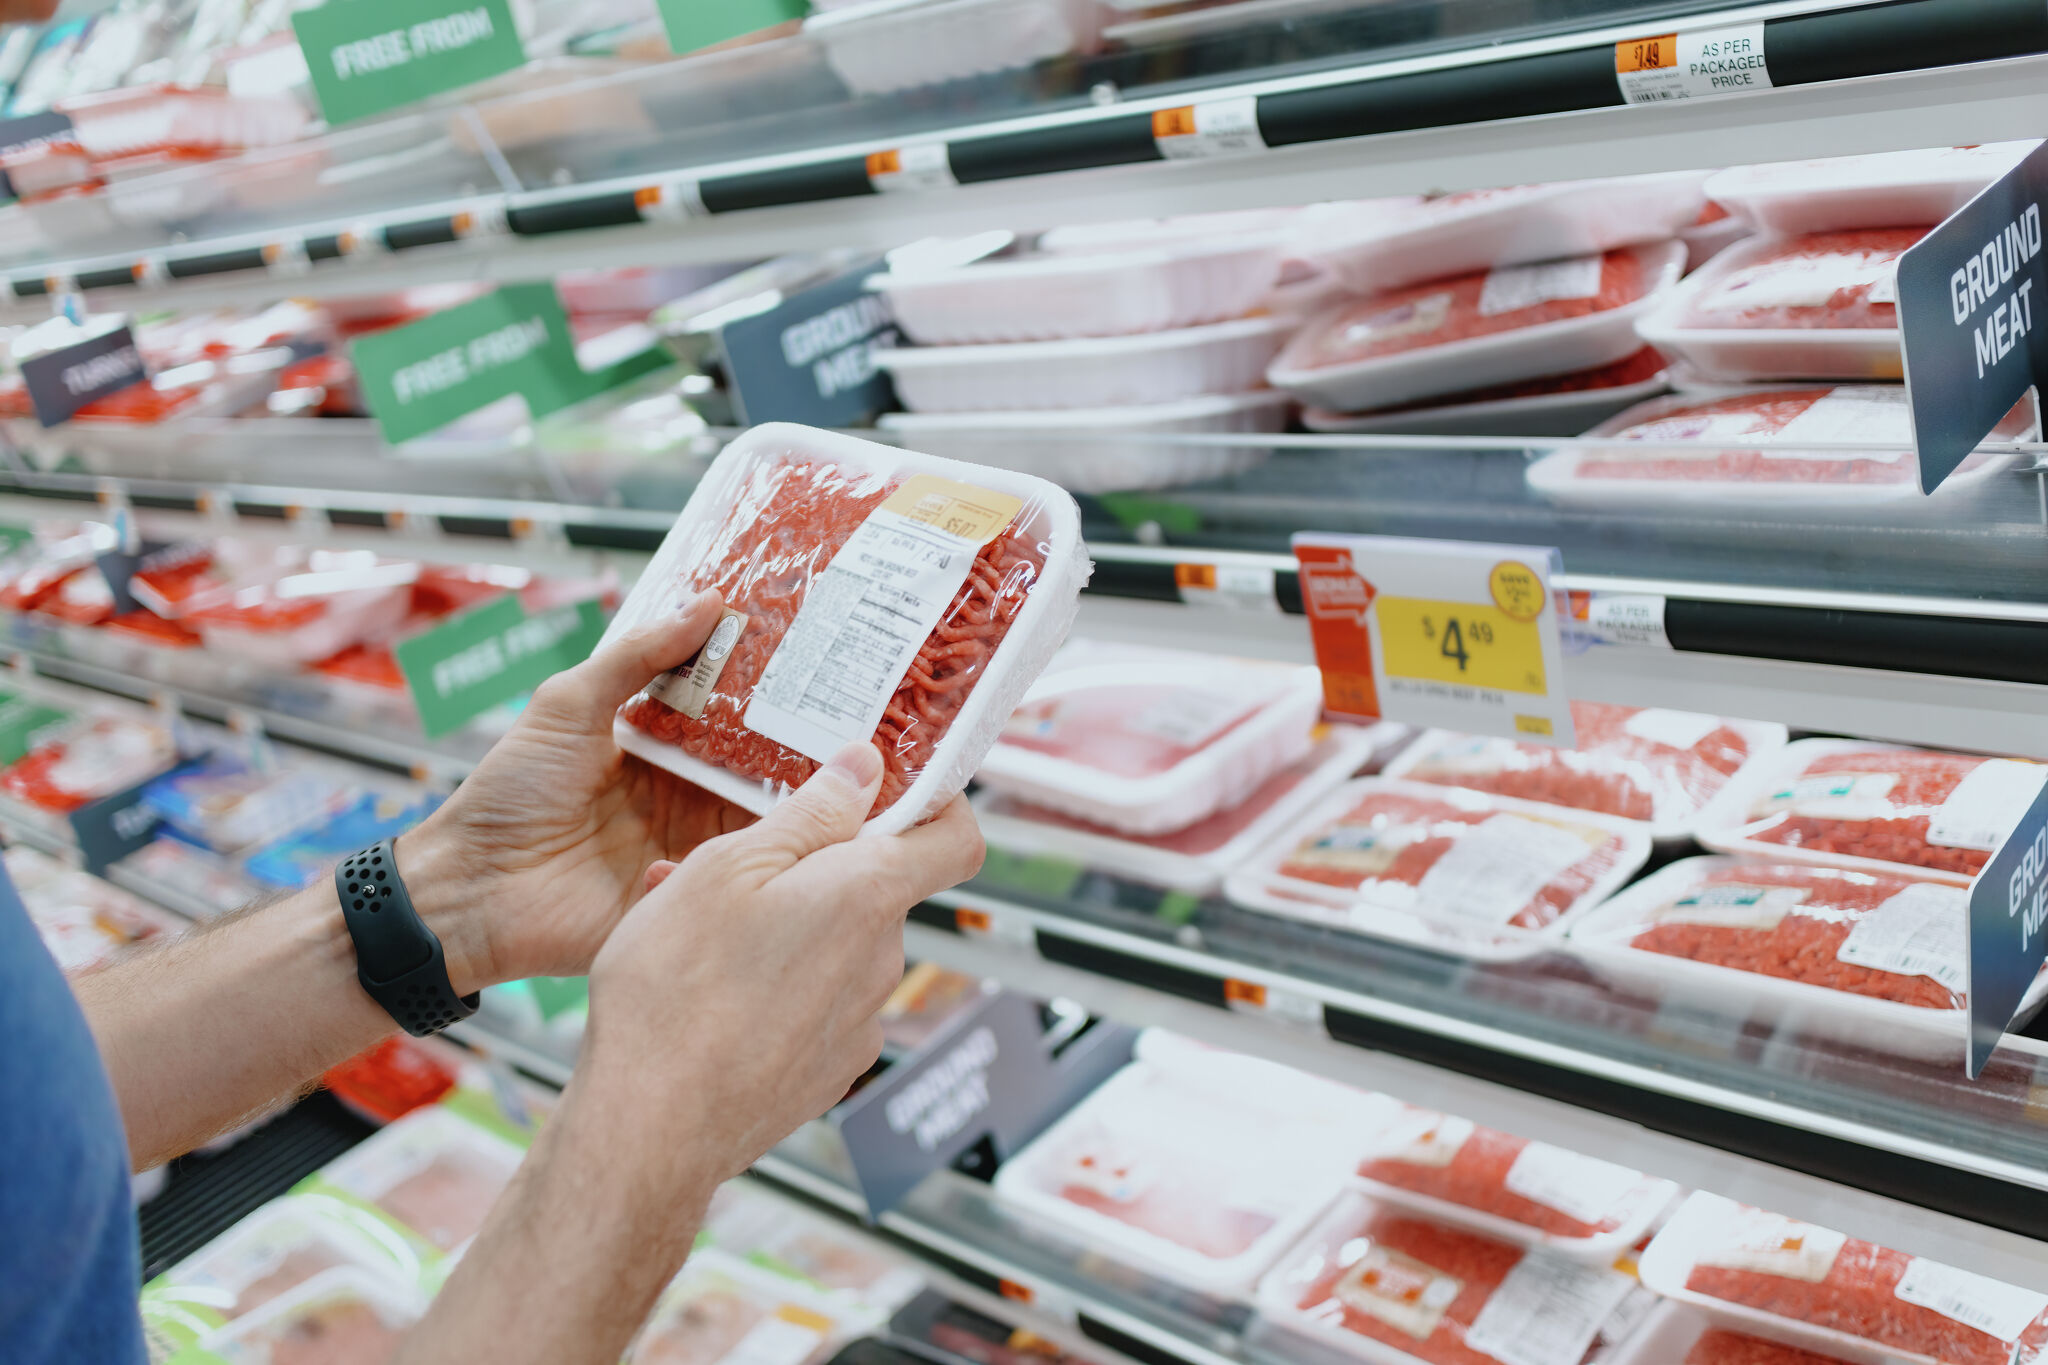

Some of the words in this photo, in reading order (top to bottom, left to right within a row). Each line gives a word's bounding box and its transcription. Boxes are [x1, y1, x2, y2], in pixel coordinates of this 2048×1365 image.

[330, 29, 413, 81] FREE
[408, 6, 495, 59] FROM
[1690, 55, 1765, 76] PACKAGED
[1702, 44, 1719, 57] AS
[1724, 38, 1751, 54] PER
[1711, 73, 1754, 88] PRICE
[1950, 202, 2042, 326] GROUND
[392, 346, 470, 405] FREE
[468, 315, 550, 374] FROM
[780, 295, 893, 368] GROUN
[1974, 278, 2033, 380] MEAT
[2009, 819, 2048, 918] GRO
